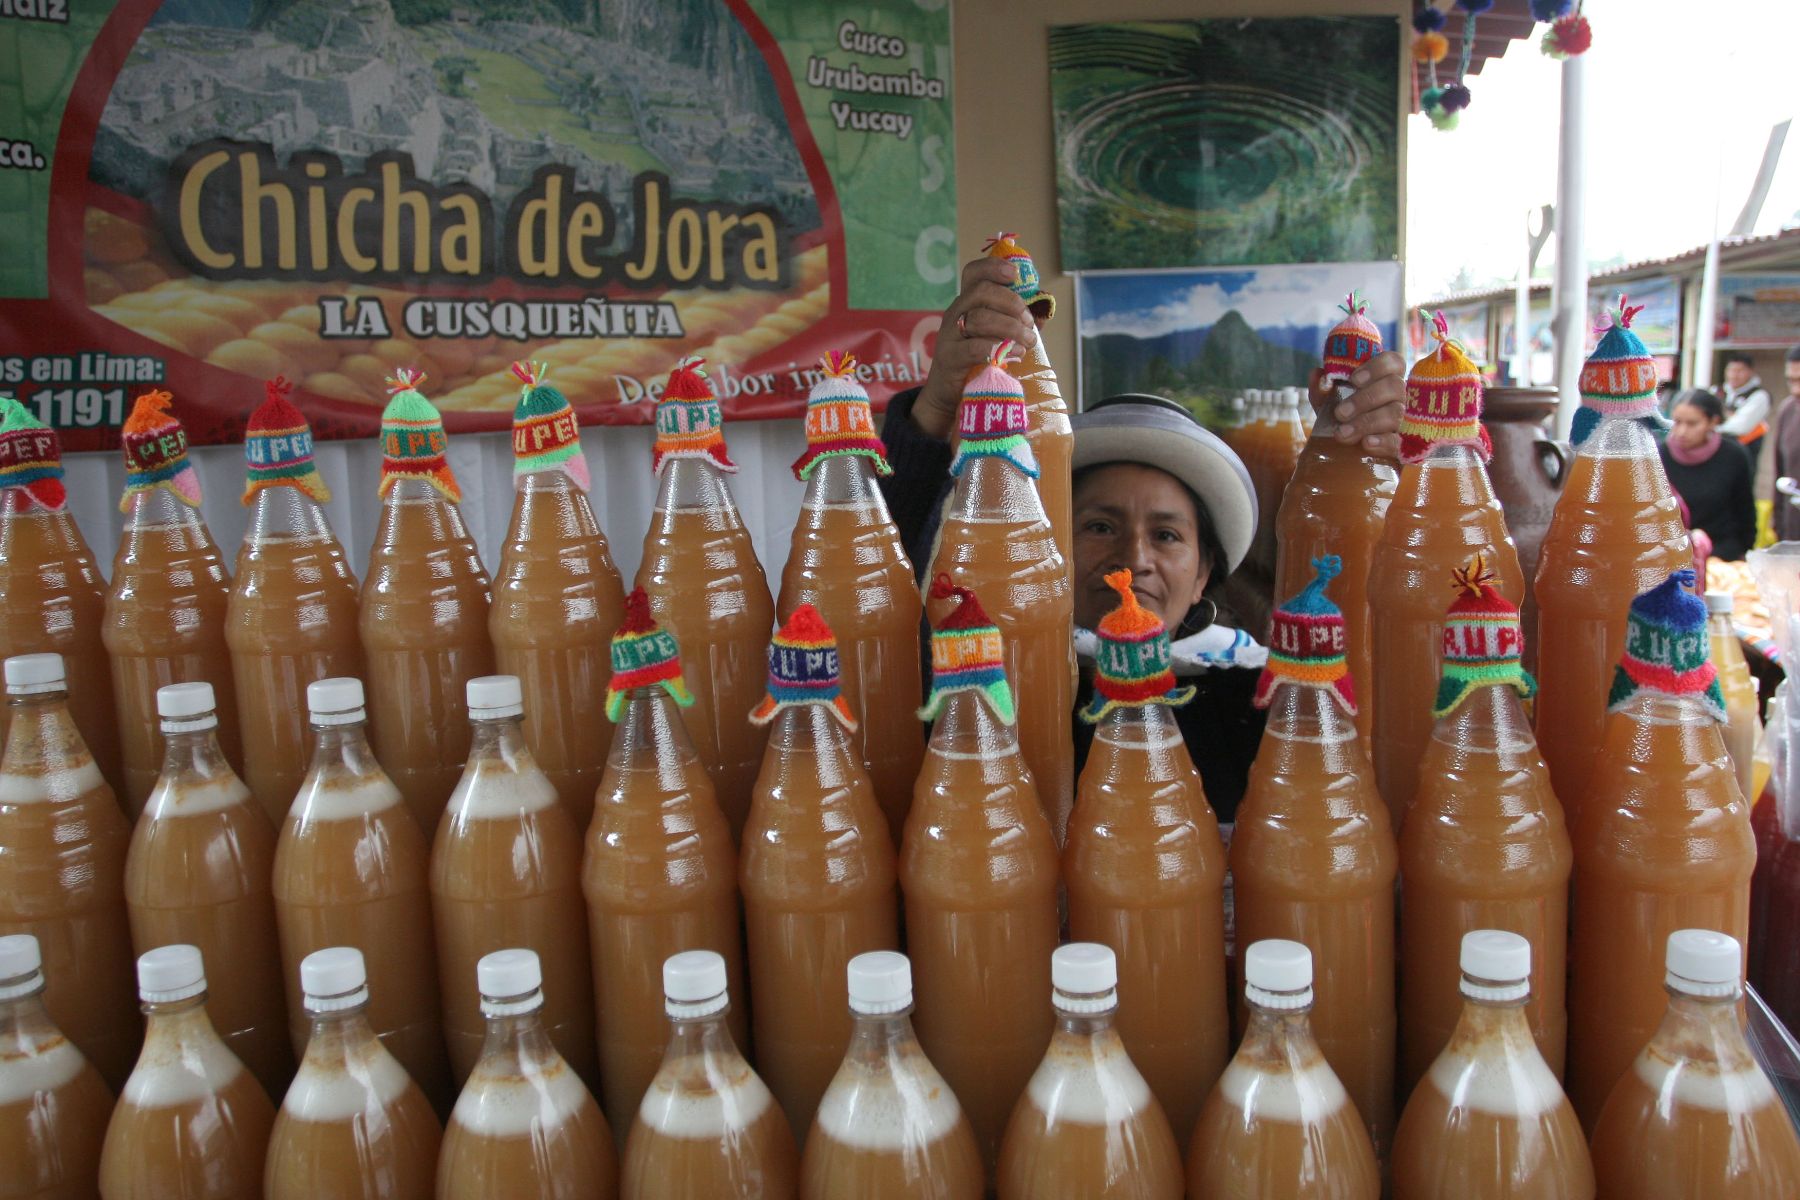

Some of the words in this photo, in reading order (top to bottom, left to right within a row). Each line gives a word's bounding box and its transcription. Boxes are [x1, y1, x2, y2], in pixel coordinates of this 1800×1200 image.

[840, 22, 904, 57] Cusco
[808, 57, 943, 98] Urubamba
[831, 102, 912, 138] Yucay
[179, 150, 481, 276] Chicha
[517, 174, 604, 277] de
[625, 180, 780, 282] Jora
[322, 300, 389, 336] LA
[405, 300, 682, 338] CUSQUEÑITA
[31, 357, 73, 381] en
[80, 353, 163, 382] Lima:
[706, 363, 775, 400] abor
[790, 351, 922, 391] imerial
